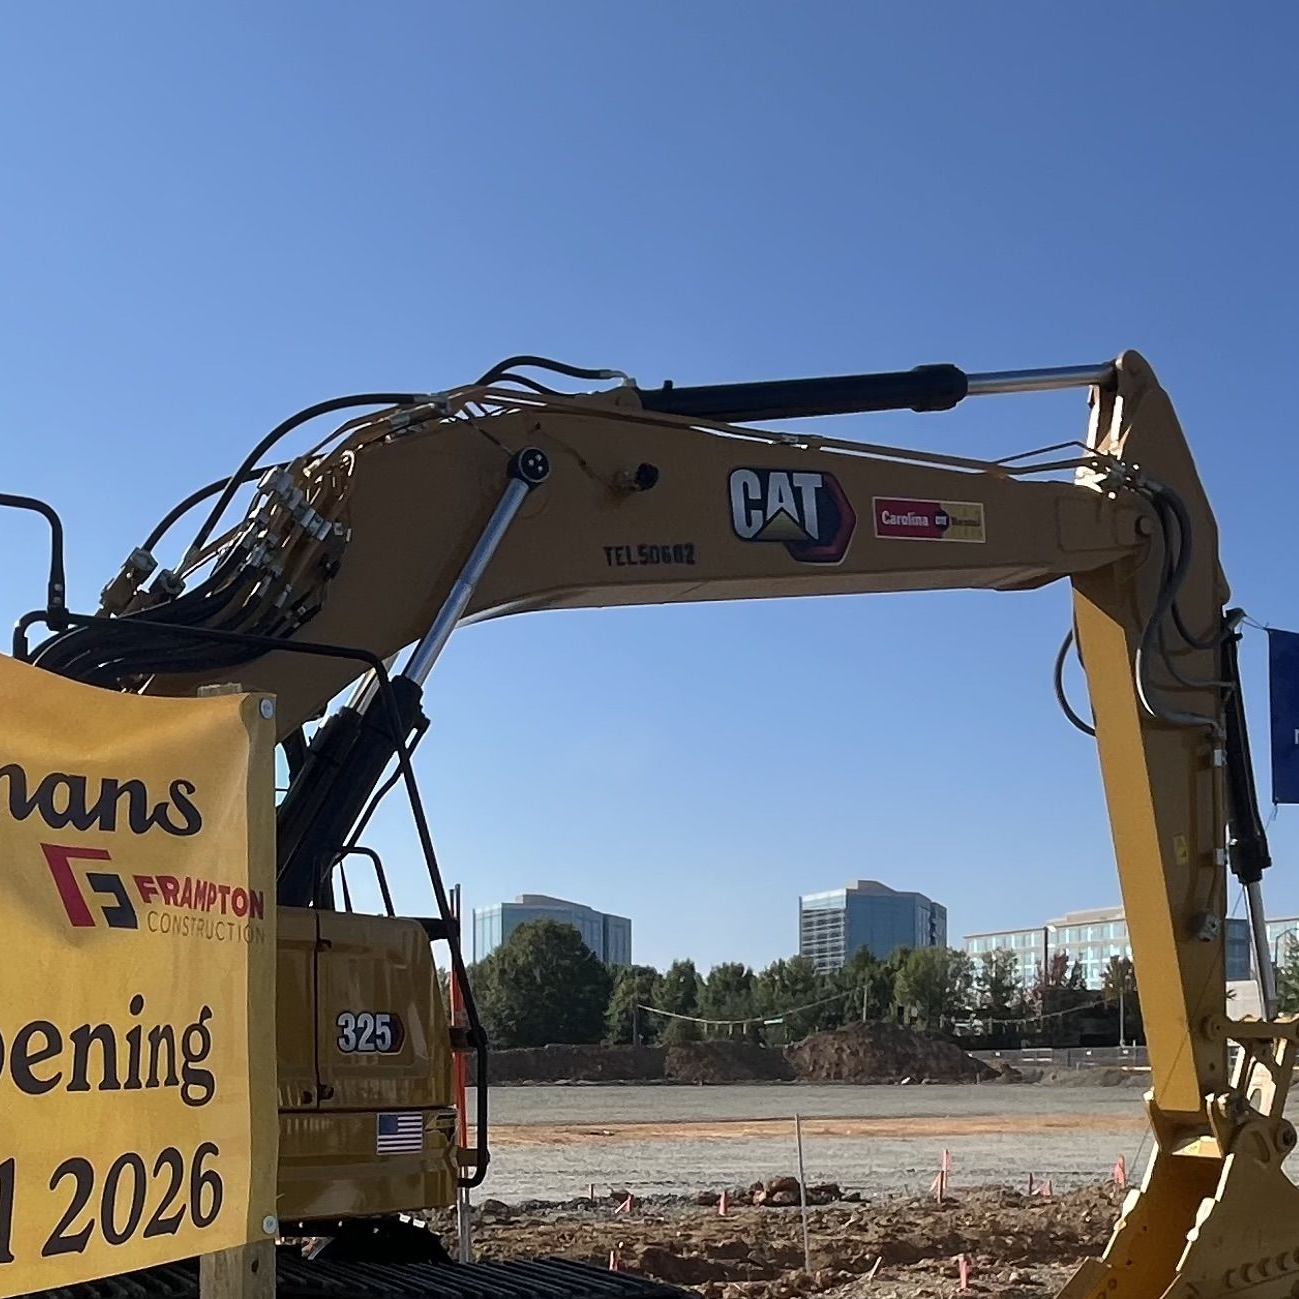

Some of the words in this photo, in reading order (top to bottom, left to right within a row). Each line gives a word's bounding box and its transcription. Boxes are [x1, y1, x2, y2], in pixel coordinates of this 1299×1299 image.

[729, 468, 823, 540] CAT
[881, 510, 929, 527] Carolina
[132, 874, 265, 920] FRAMPTON
[147, 910, 266, 944] CONSTRUCTION
[337, 1012, 392, 1053] 325
[41, 1142, 224, 1258] 2026
